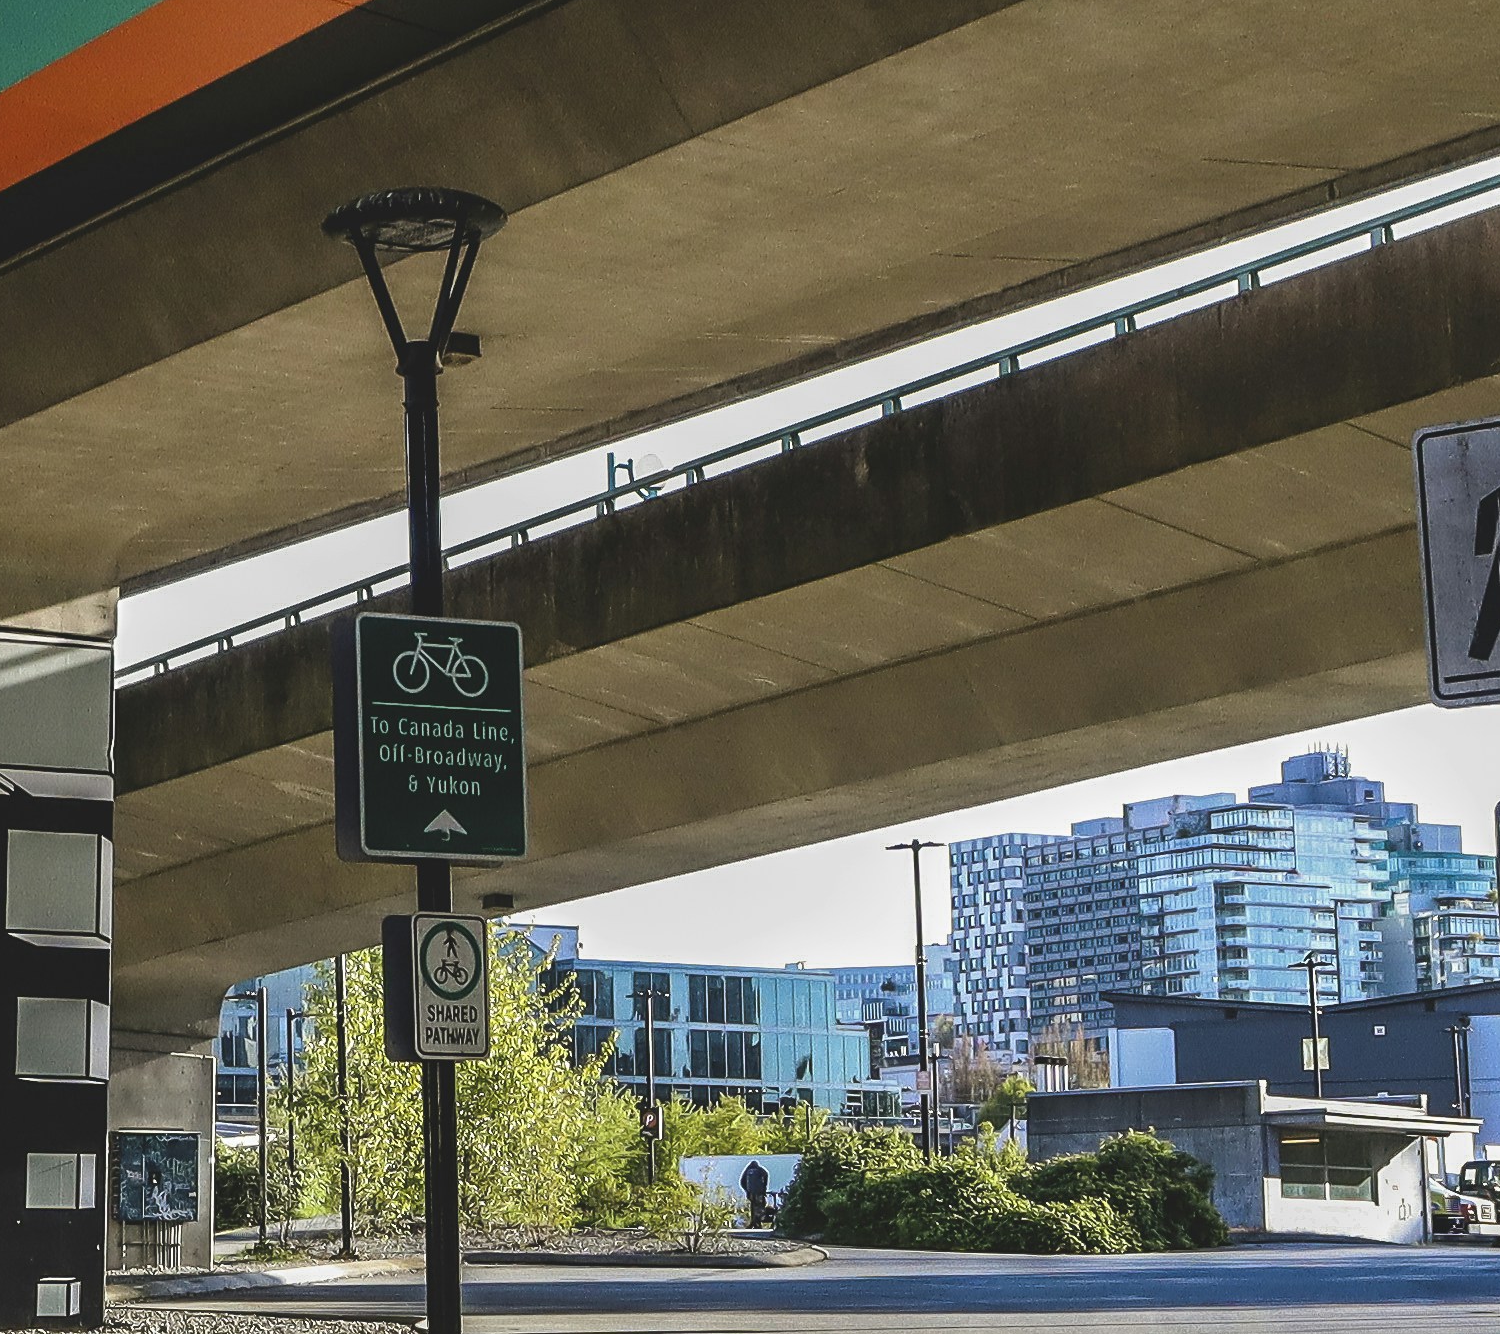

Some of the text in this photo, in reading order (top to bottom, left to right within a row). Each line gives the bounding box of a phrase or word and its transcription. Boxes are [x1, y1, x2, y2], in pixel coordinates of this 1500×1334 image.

[370, 716, 514, 744] To Canada Line,
[379, 743, 507, 773] Off-Broadway,
[408, 774, 480, 796] & Yukon
[427, 1004, 478, 1023] SHARED
[425, 1026, 480, 1045] PATHWAY
